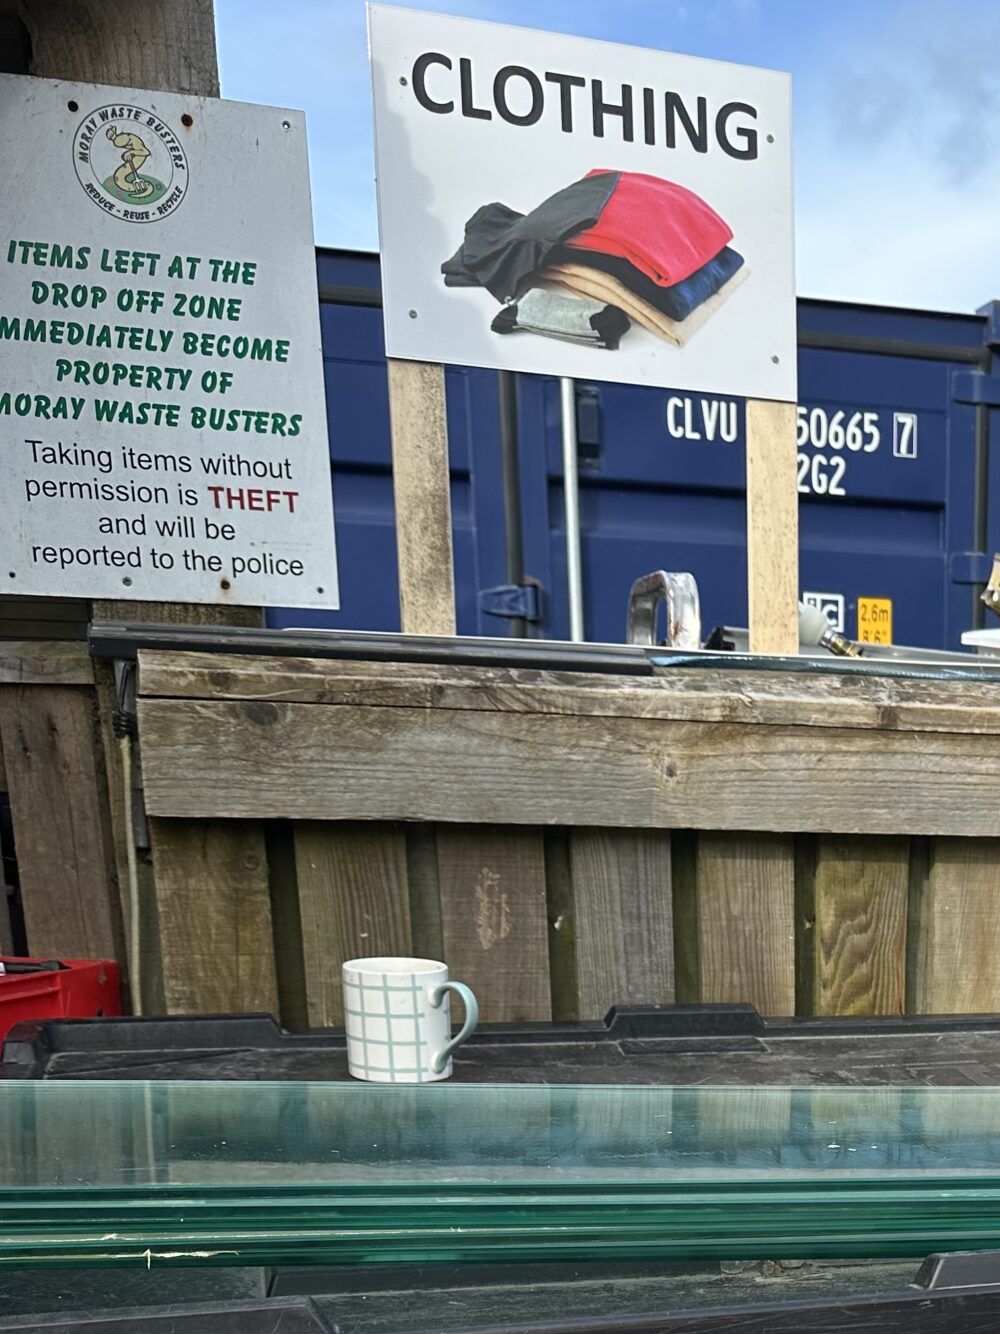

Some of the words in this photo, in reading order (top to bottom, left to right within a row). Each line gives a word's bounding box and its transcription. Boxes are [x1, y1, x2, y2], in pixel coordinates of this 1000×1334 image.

[411, 52, 758, 160] CLOTHING
[78, 117, 99, 163] MORAY
[98, 107, 142, 122] WASTE
[146, 117, 185, 171] BUSTERS
[85, 182, 116, 212] REDUCE
[122, 209, 150, 220] REUSE
[157, 185, 183, 215] RECYCLE
[7, 240, 91, 270] ITEMS
[100, 248, 160, 276] LEFT
[168, 255, 201, 280] AT
[209, 259, 257, 285] THE
[31, 281, 107, 309] DROP
[117, 288, 165, 314] OFF
[173, 293, 242, 321] ZONE
[0, 316, 173, 352] MMEDIATELY
[183, 332, 290, 362] BECOME
[56, 359, 192, 391] PROPERTY
[201, 370, 233, 394] OF
[95, 399, 181, 427] WASTE
[191, 406, 303, 437] BUSTERS
[667, 397, 737, 442] CLVU
[896, 414, 915, 456] 7
[24, 440, 112, 473] Taking
[122, 446, 192, 473] items
[200, 453, 293, 479] without
[25, 478, 169, 504] permission
[178, 483, 198, 506] is
[207, 486, 299, 513] THEFT
[99, 514, 146, 535] and
[155, 516, 195, 538] will
[205, 518, 236, 540] be
[32, 545, 142, 569] reported
[151, 549, 174, 570] to
[183, 550, 222, 572] the
[231, 553, 304, 578] police
